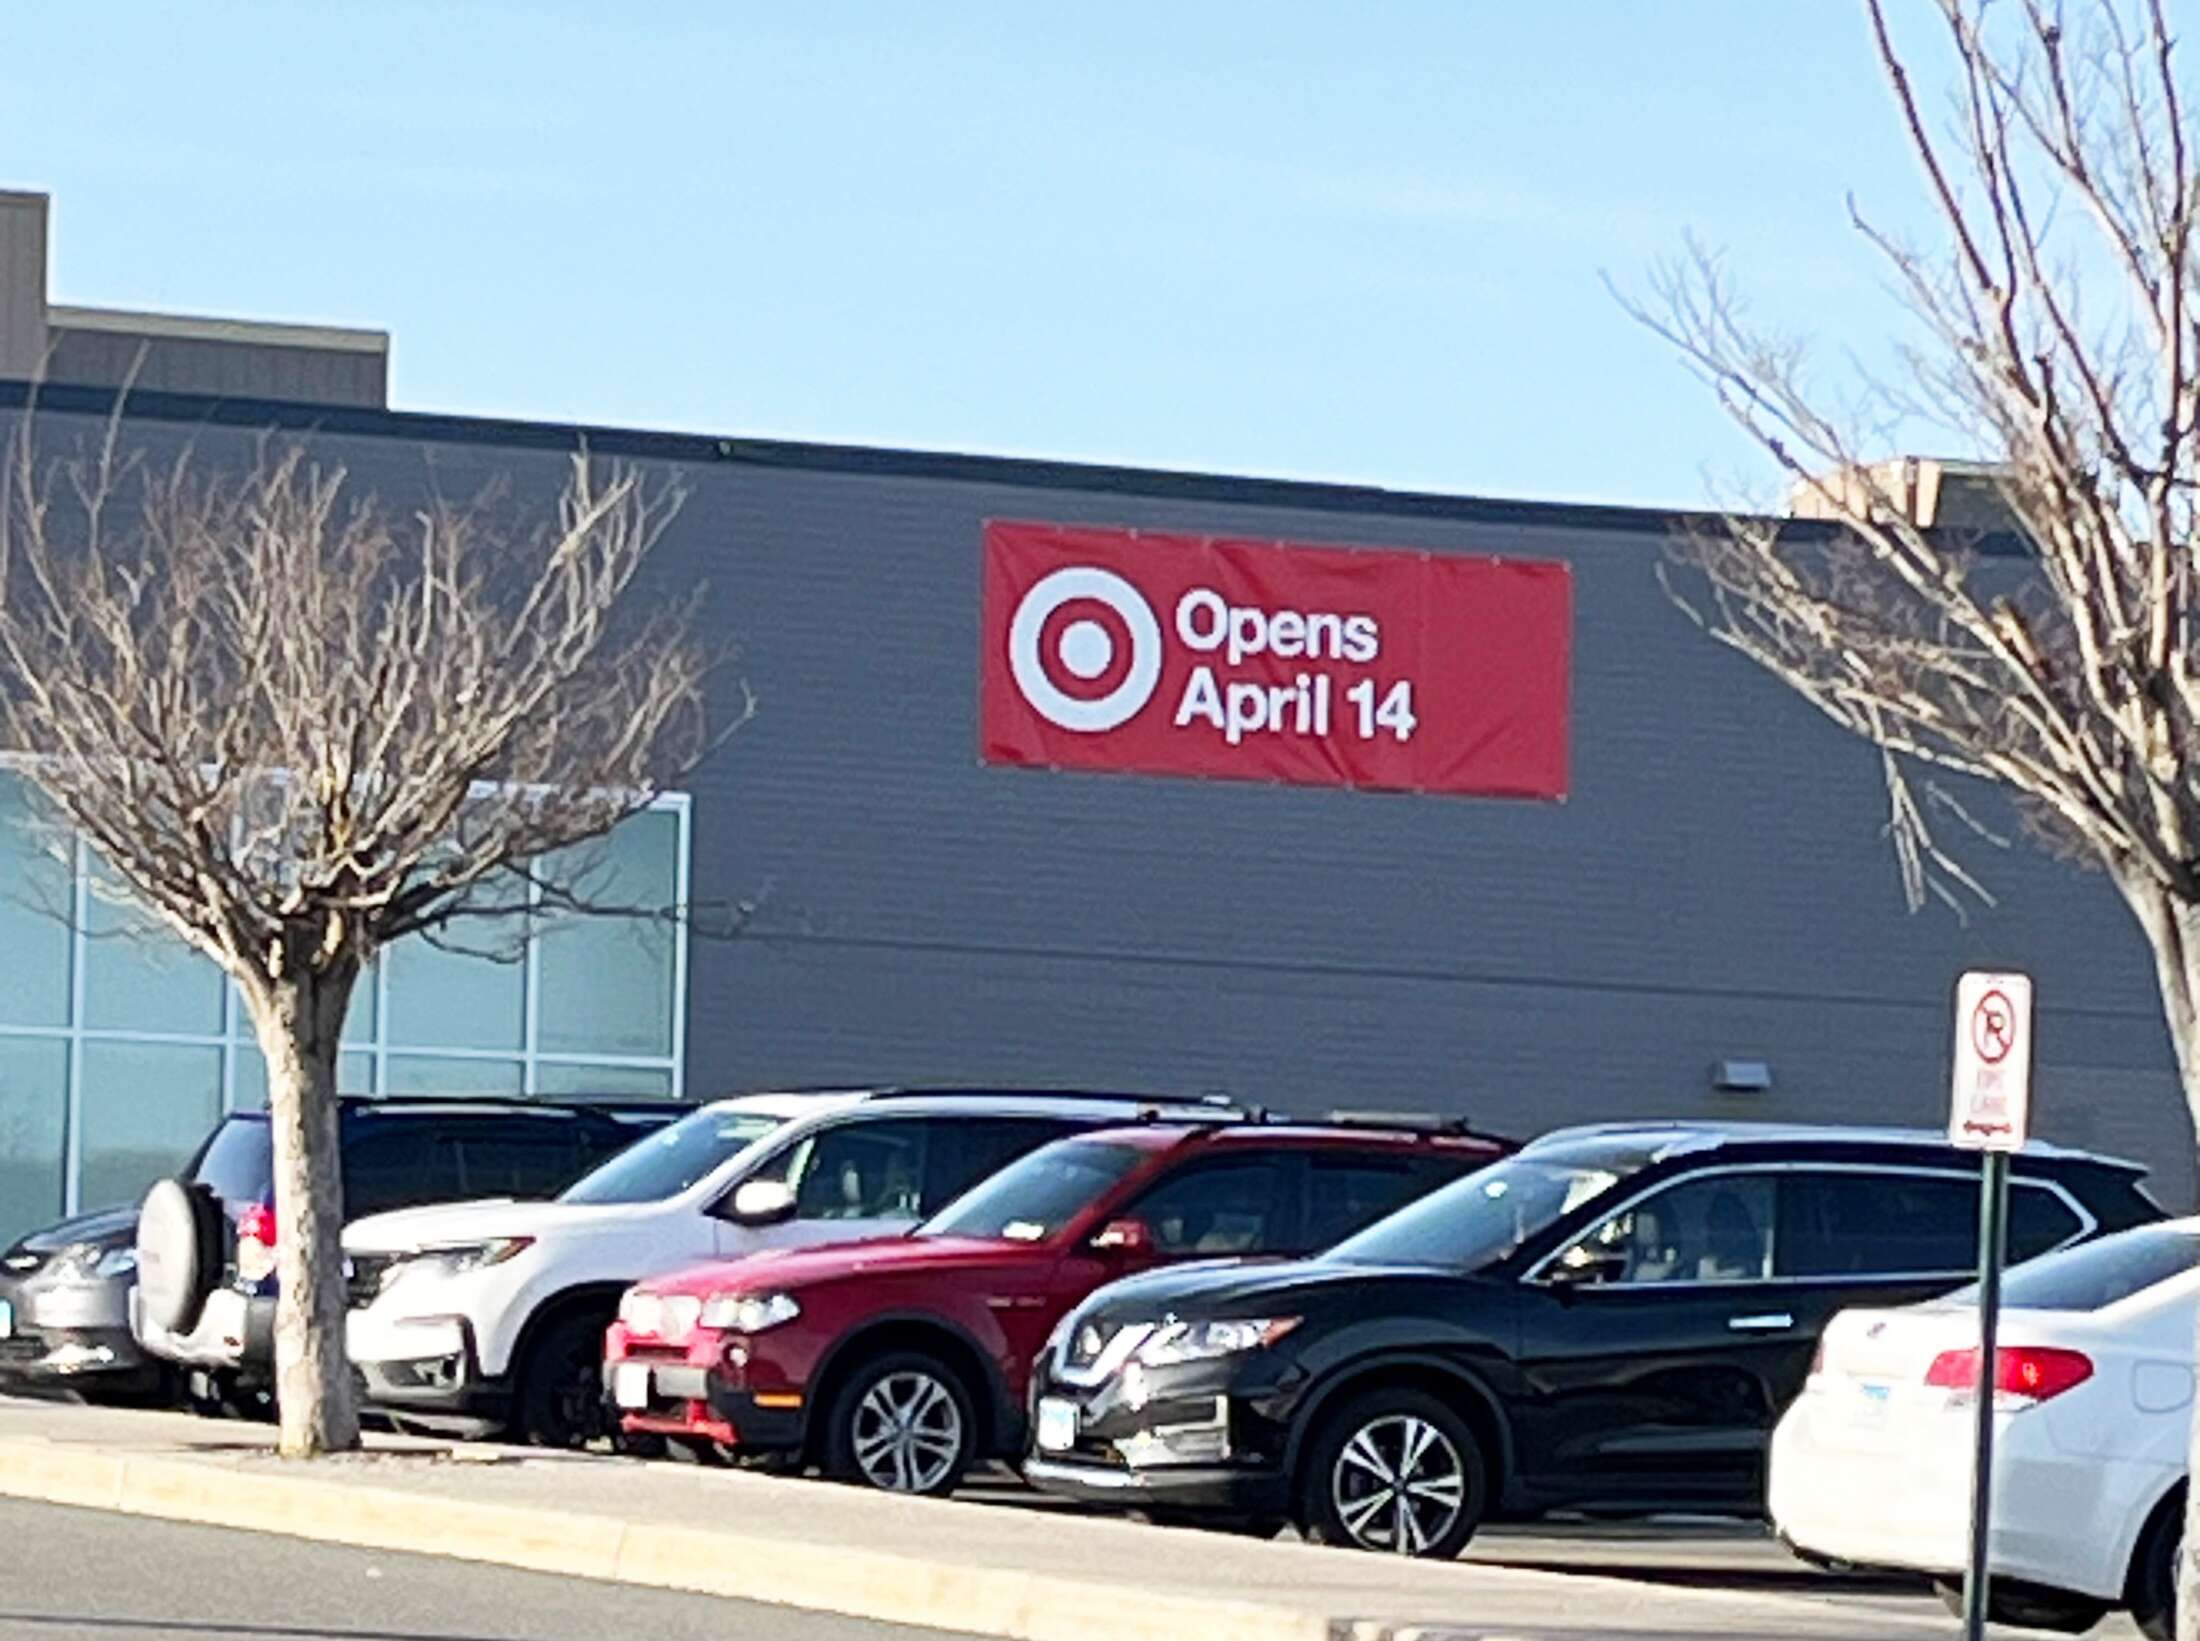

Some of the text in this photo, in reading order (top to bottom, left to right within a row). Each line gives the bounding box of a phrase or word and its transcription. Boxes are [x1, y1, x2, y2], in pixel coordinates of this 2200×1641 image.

[1175, 588, 1378, 665] Opens
[1174, 667, 1417, 745] April 14
